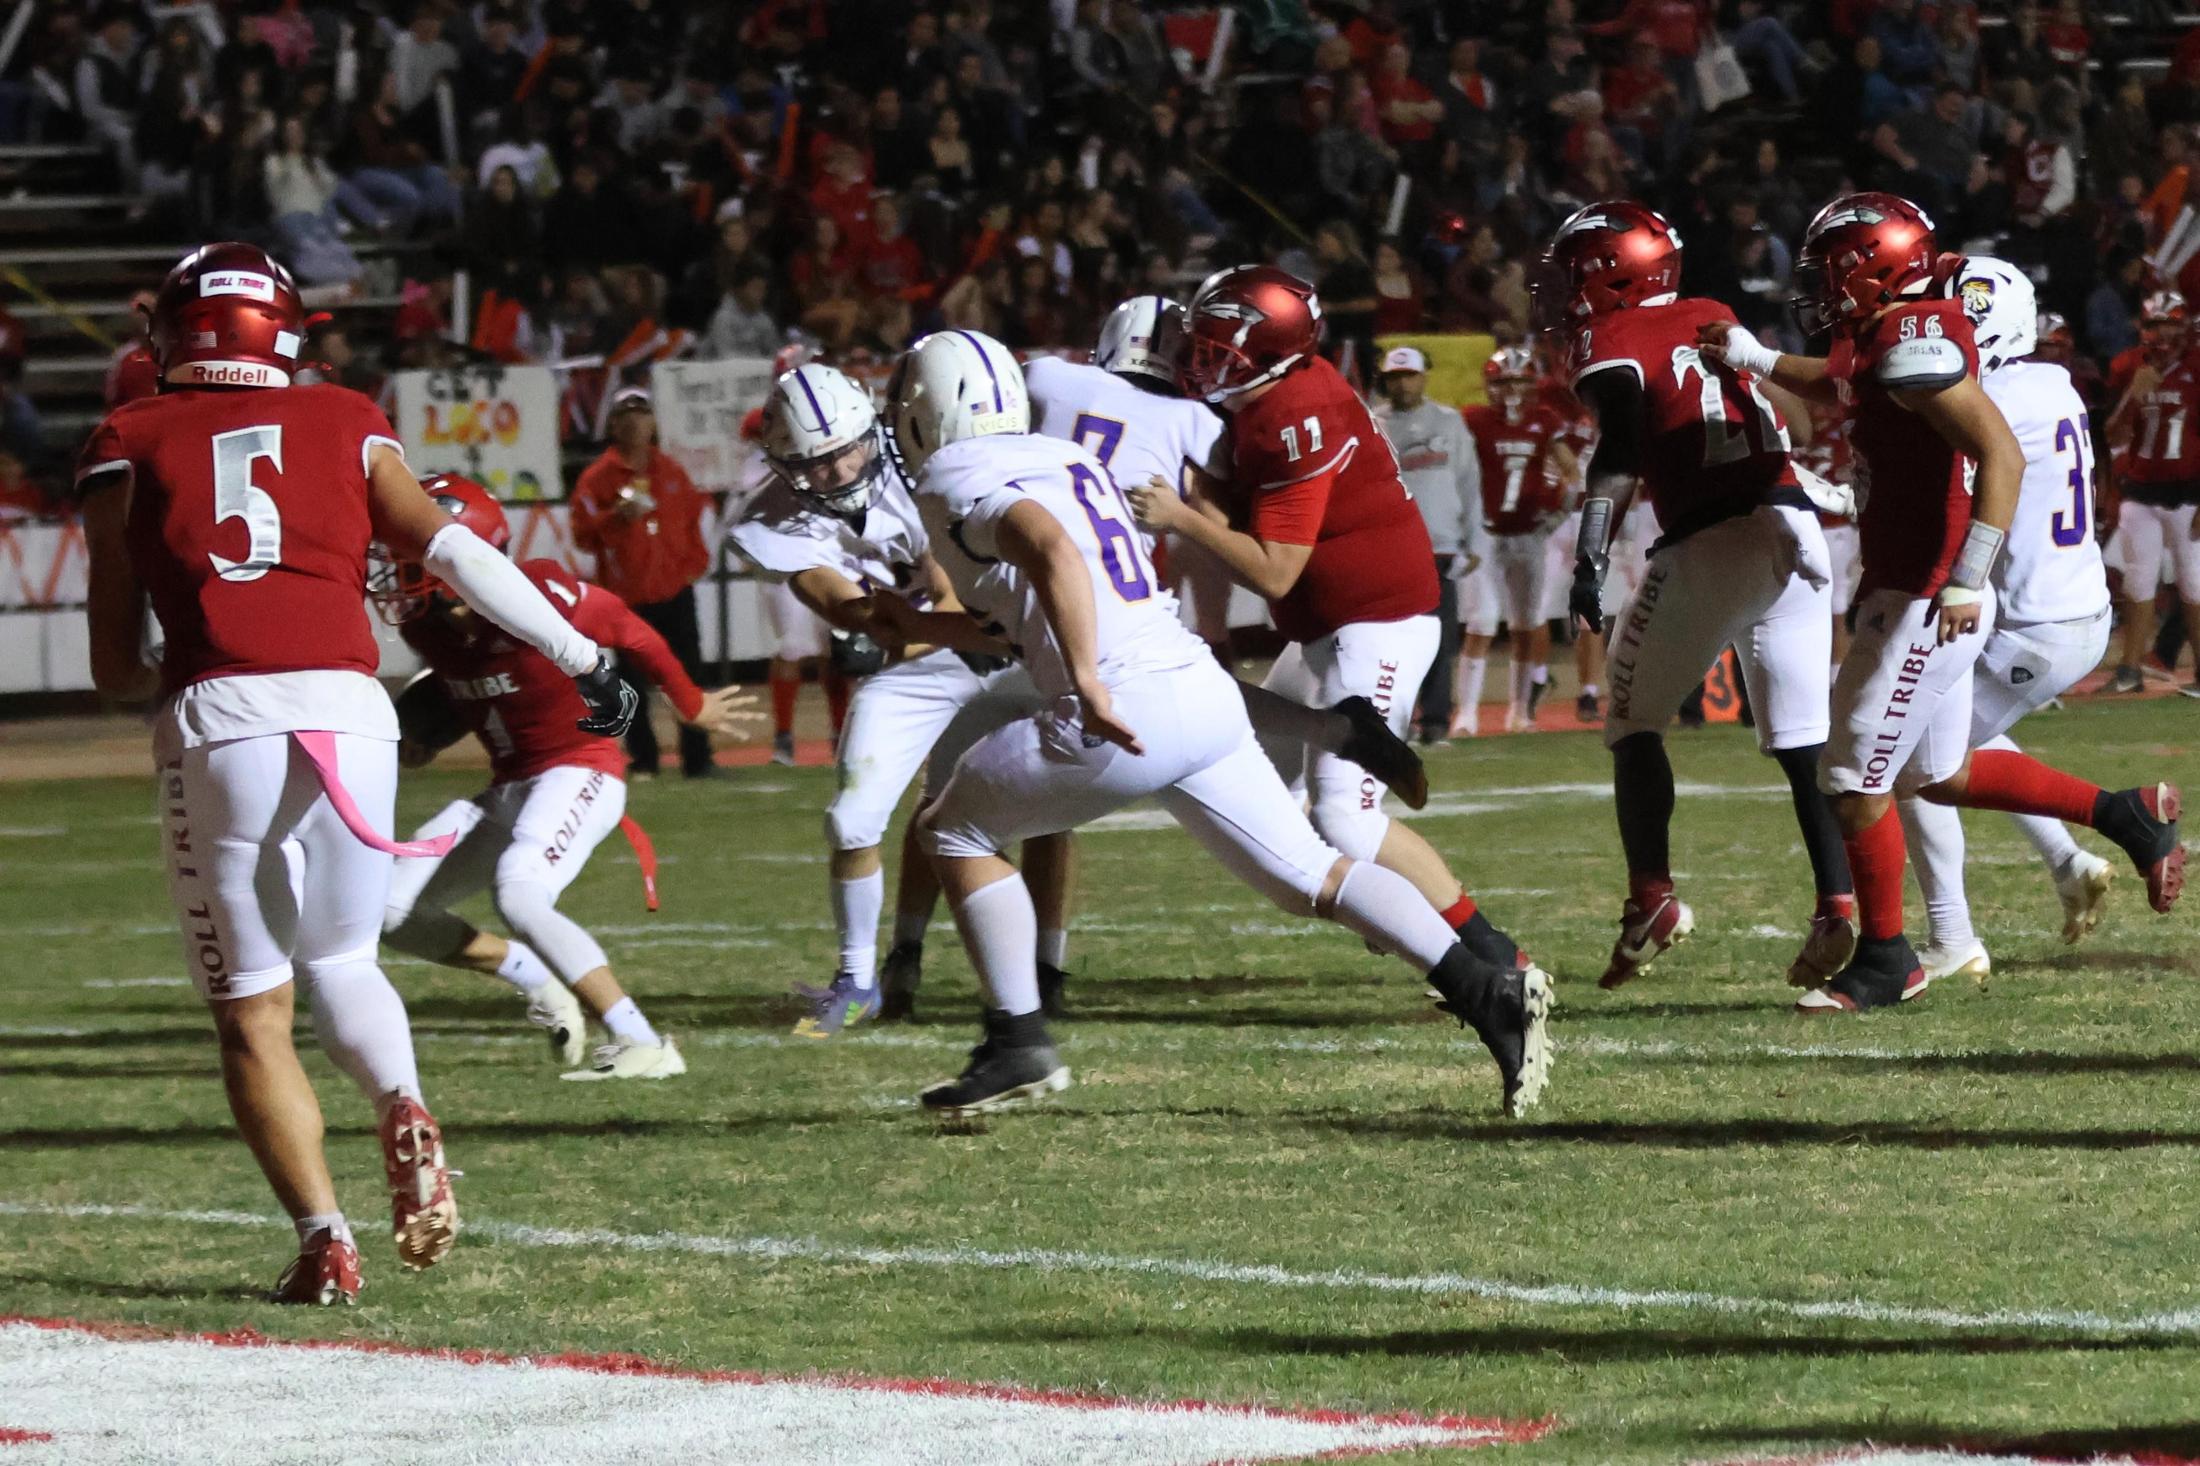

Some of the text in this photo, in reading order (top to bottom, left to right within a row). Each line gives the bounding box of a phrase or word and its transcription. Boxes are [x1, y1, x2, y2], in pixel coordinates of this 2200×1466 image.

[1899, 315, 1943, 342] 56
[192, 366, 269, 384] Riddell
[426, 365, 505, 402] GET
[1280, 416, 1323, 462] 11
[208, 424, 284, 583] 5
[1612, 567, 1668, 720] ROLL TRIBE
[1704, 659, 1732, 711] 3
[1862, 643, 1937, 789] ROLL TRIBE
[187, 901, 232, 995] ROLL
